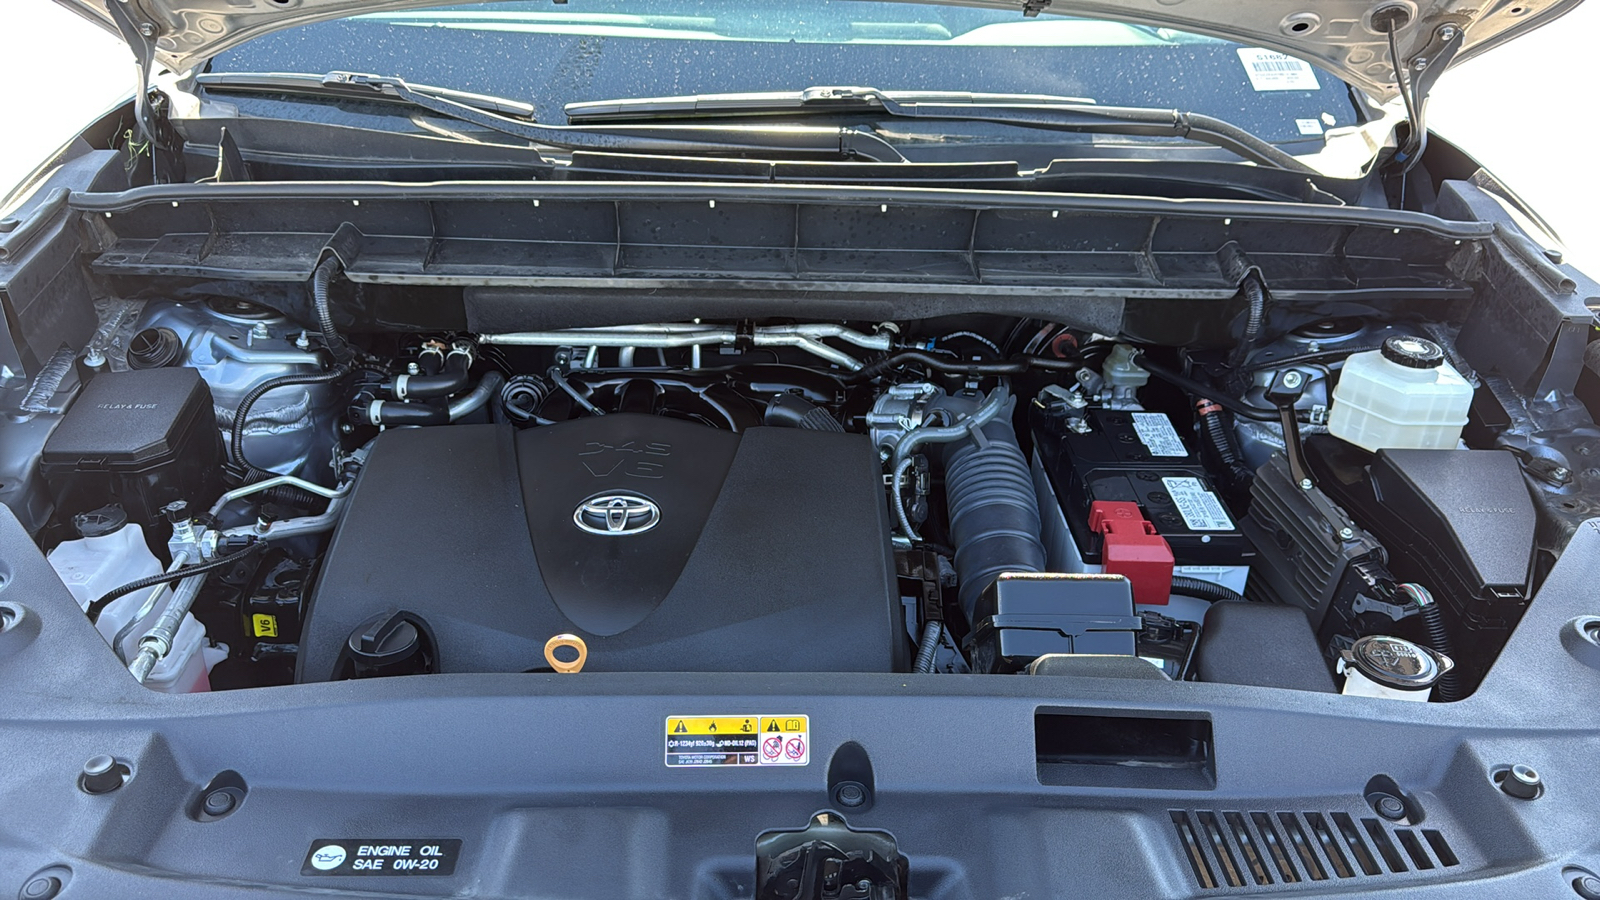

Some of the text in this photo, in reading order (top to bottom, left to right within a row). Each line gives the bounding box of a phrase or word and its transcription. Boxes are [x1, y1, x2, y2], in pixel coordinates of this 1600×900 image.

[581, 459, 664, 478] V6
[260, 620, 271, 632] V6
[744, 755, 756, 763] WS
[357, 845, 443, 856] ENGINE OIL
[352, 859, 439, 870] SAE 0W-20
